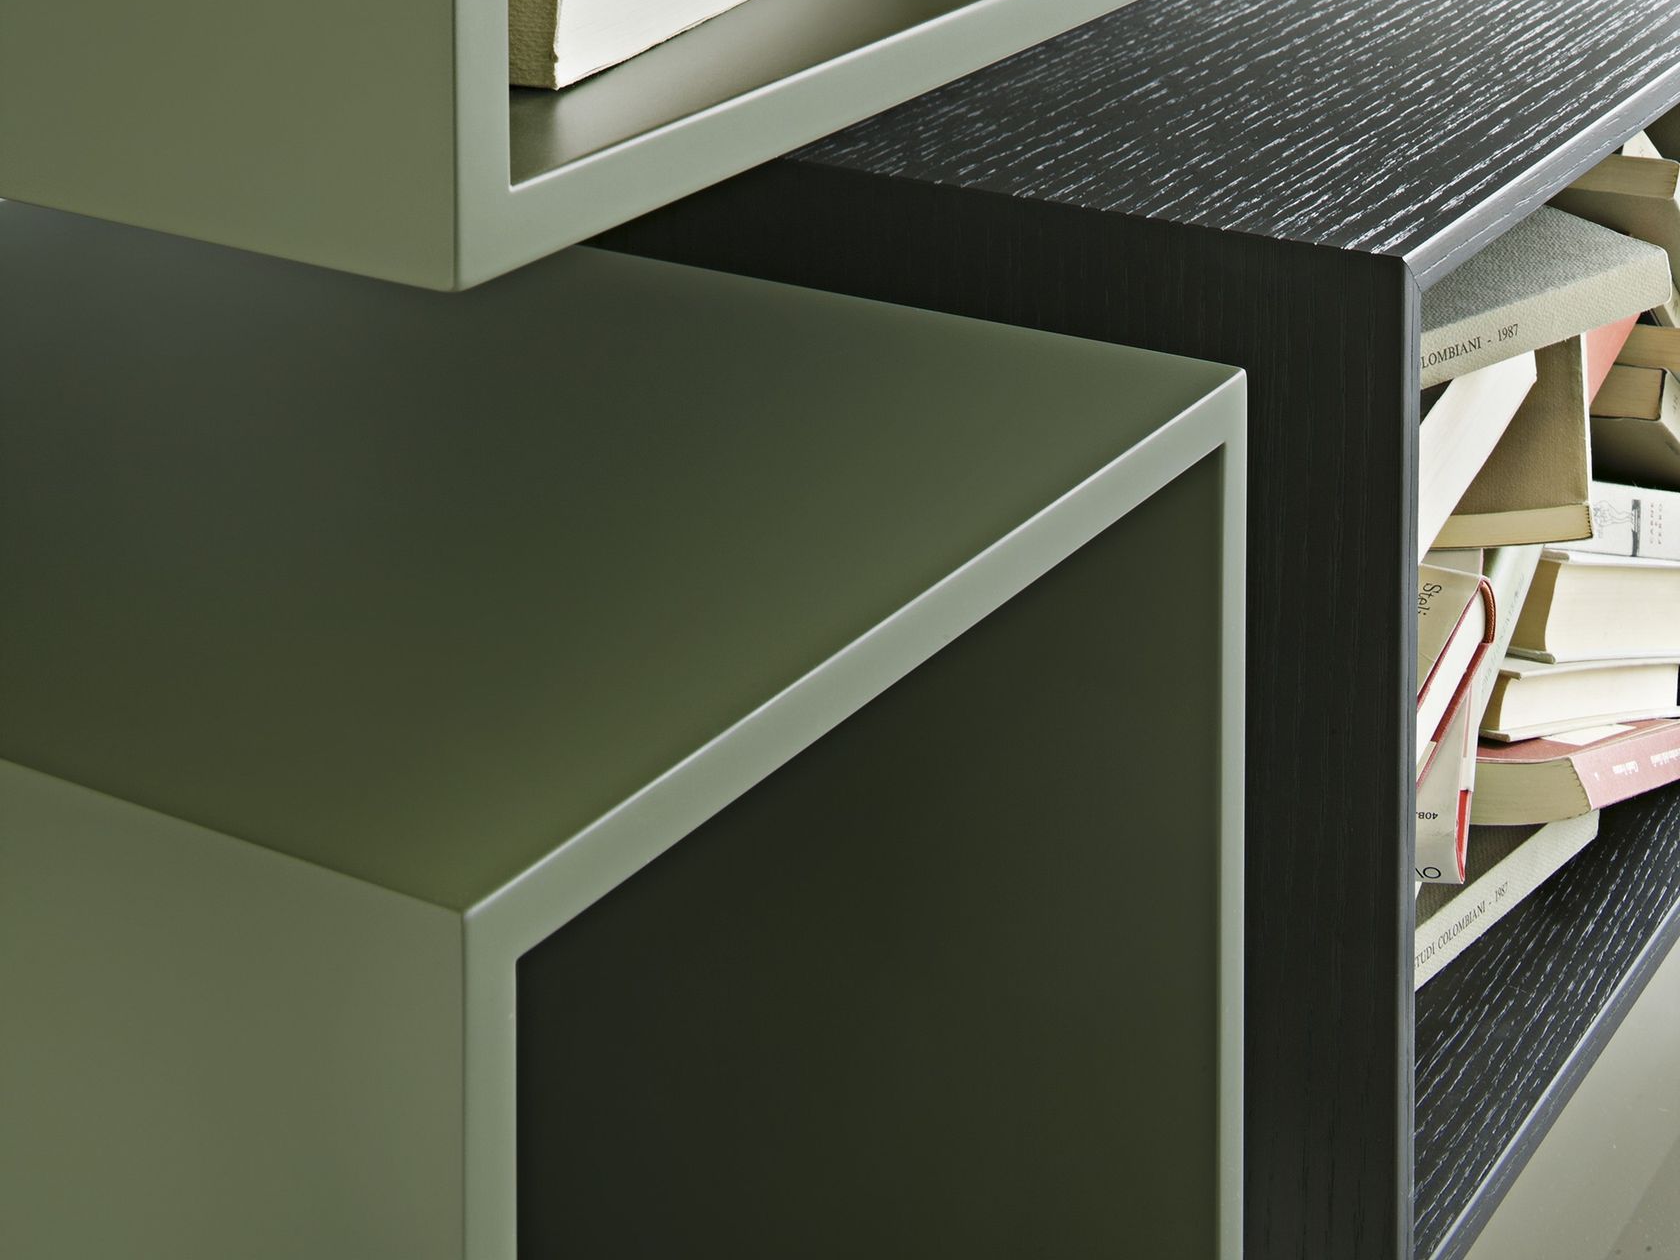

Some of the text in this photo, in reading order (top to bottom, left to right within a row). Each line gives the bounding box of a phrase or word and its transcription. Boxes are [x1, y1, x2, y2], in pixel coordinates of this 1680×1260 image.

[1497, 323, 1519, 342] 1987
[1415, 943, 1436, 969] TUDI
[1438, 900, 1487, 950] COLOMBIANI
[1494, 882, 1509, 903] 1987
